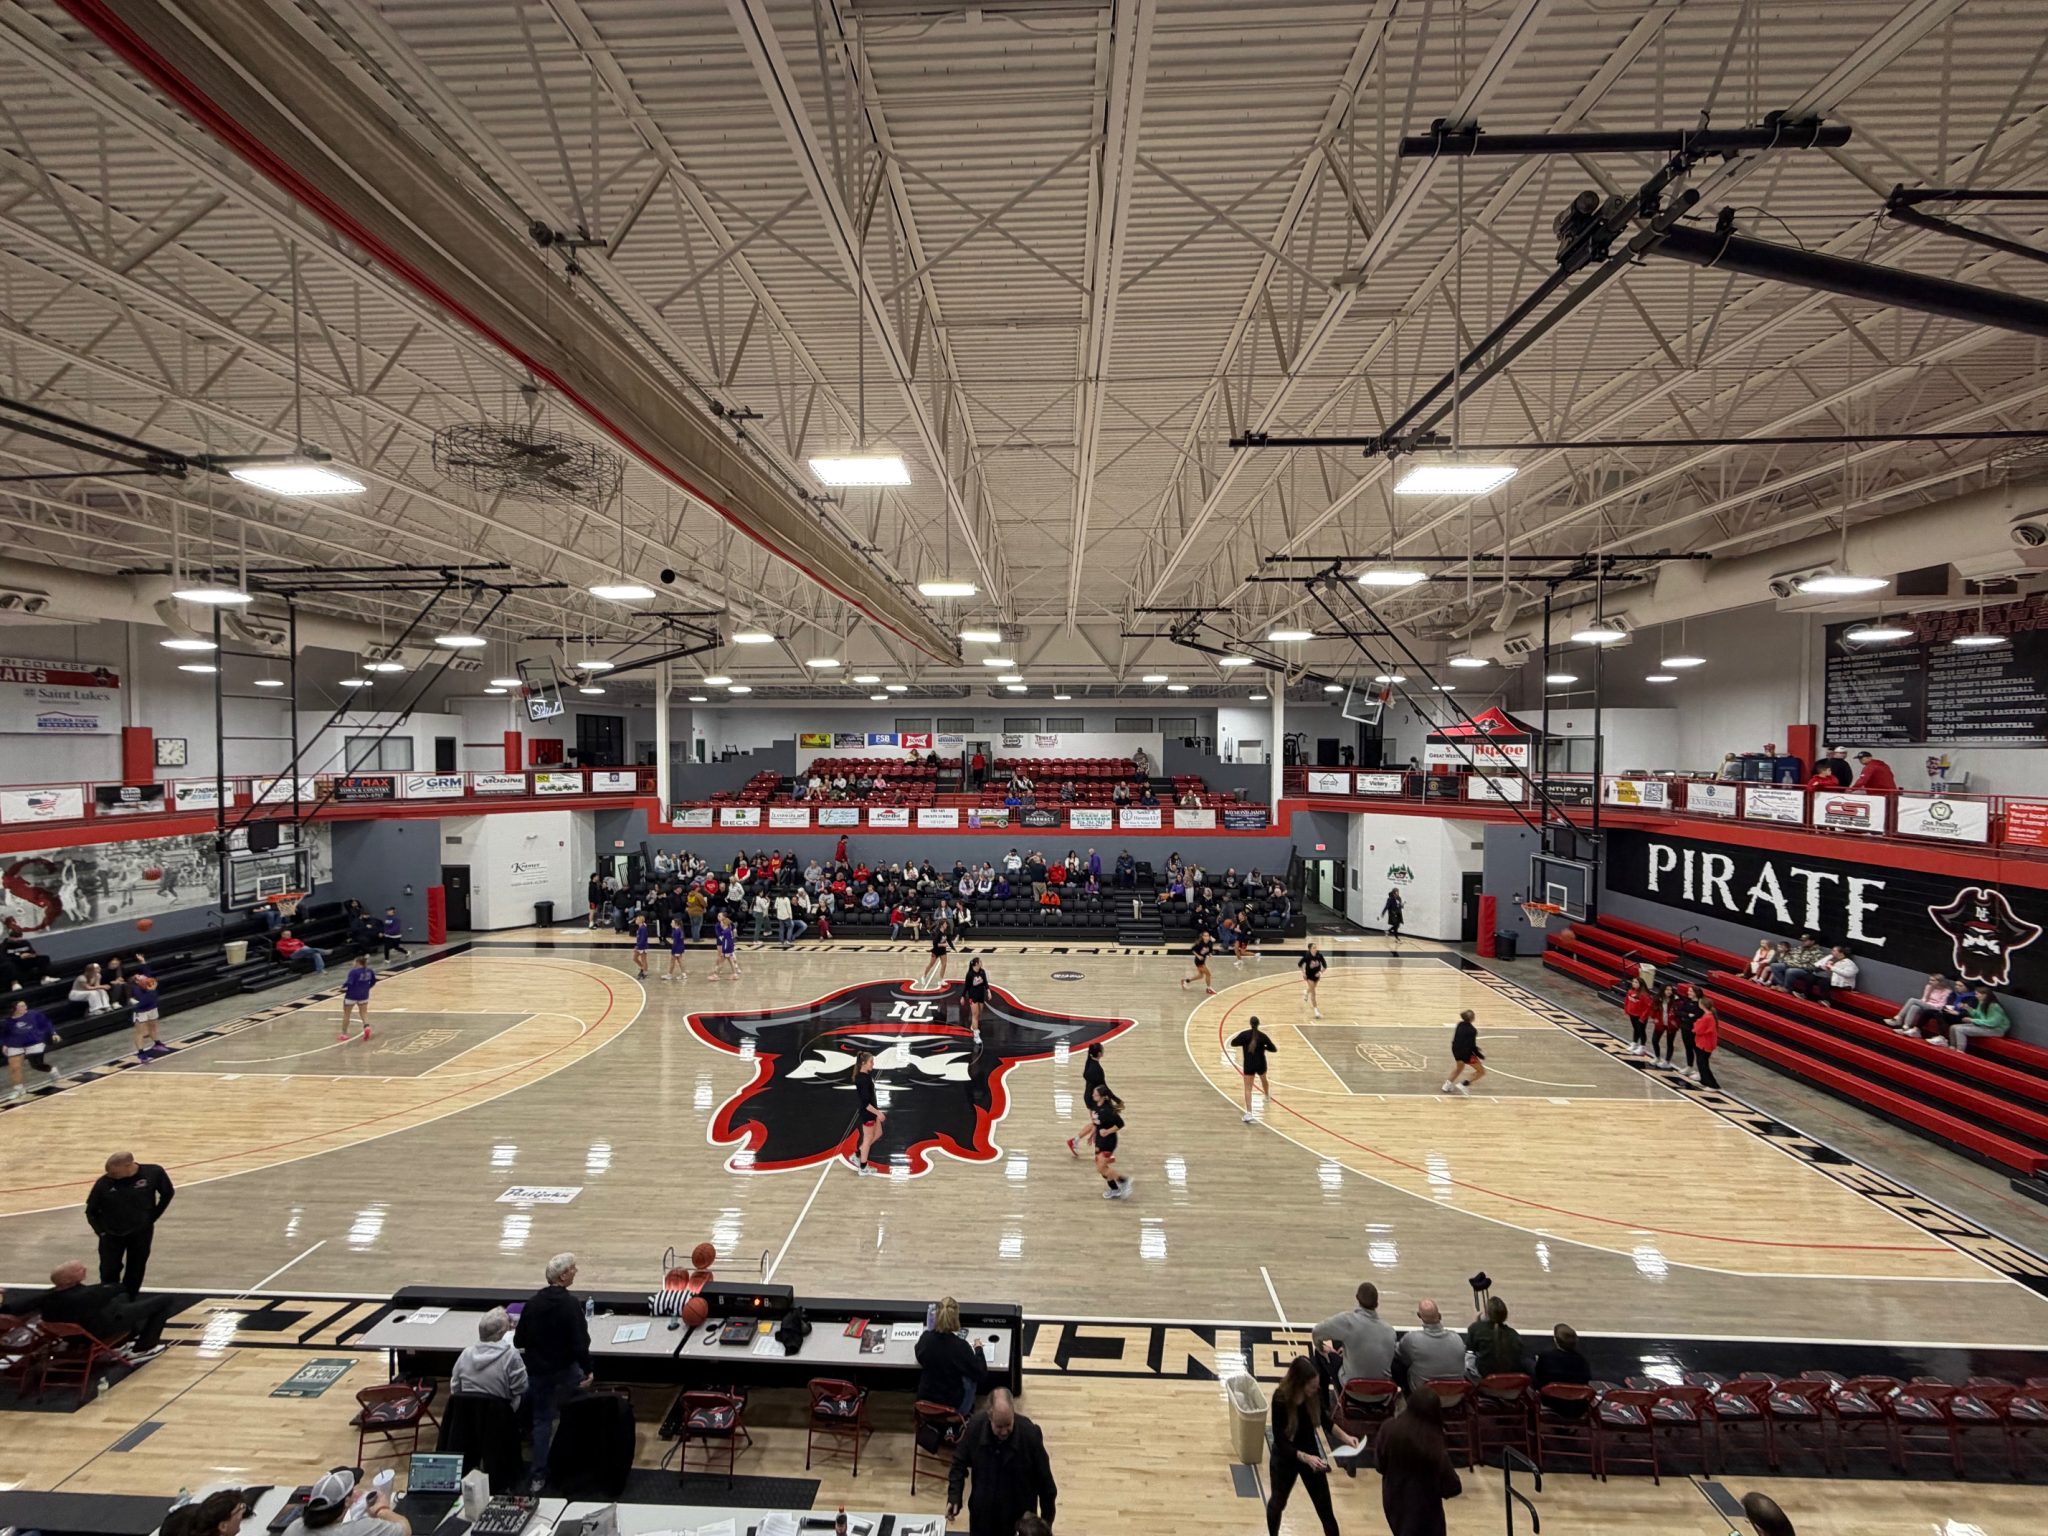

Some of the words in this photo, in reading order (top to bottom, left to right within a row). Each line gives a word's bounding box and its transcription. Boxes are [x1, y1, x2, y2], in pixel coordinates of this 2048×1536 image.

[22, 659, 89, 671] COLLEGE
[1981, 677, 2035, 686] BASKETBALL
[38, 688, 72, 700] Saint
[1981, 686, 2035, 695] BASKETBALL
[1992, 694, 2047, 703] BASKETBALL
[1993, 708, 2047, 716] BASKETBALL
[875, 734, 890, 743] FSB
[426, 777, 462, 788] GRM
[193, 784, 232, 794] THOMON
[2029, 812, 2048, 820] local
[1935, 820, 1959, 829] Family
[1648, 842, 1887, 947] PIRATE
[887, 1000, 939, 1023] NC
[894, 1330, 920, 1338] HOME
